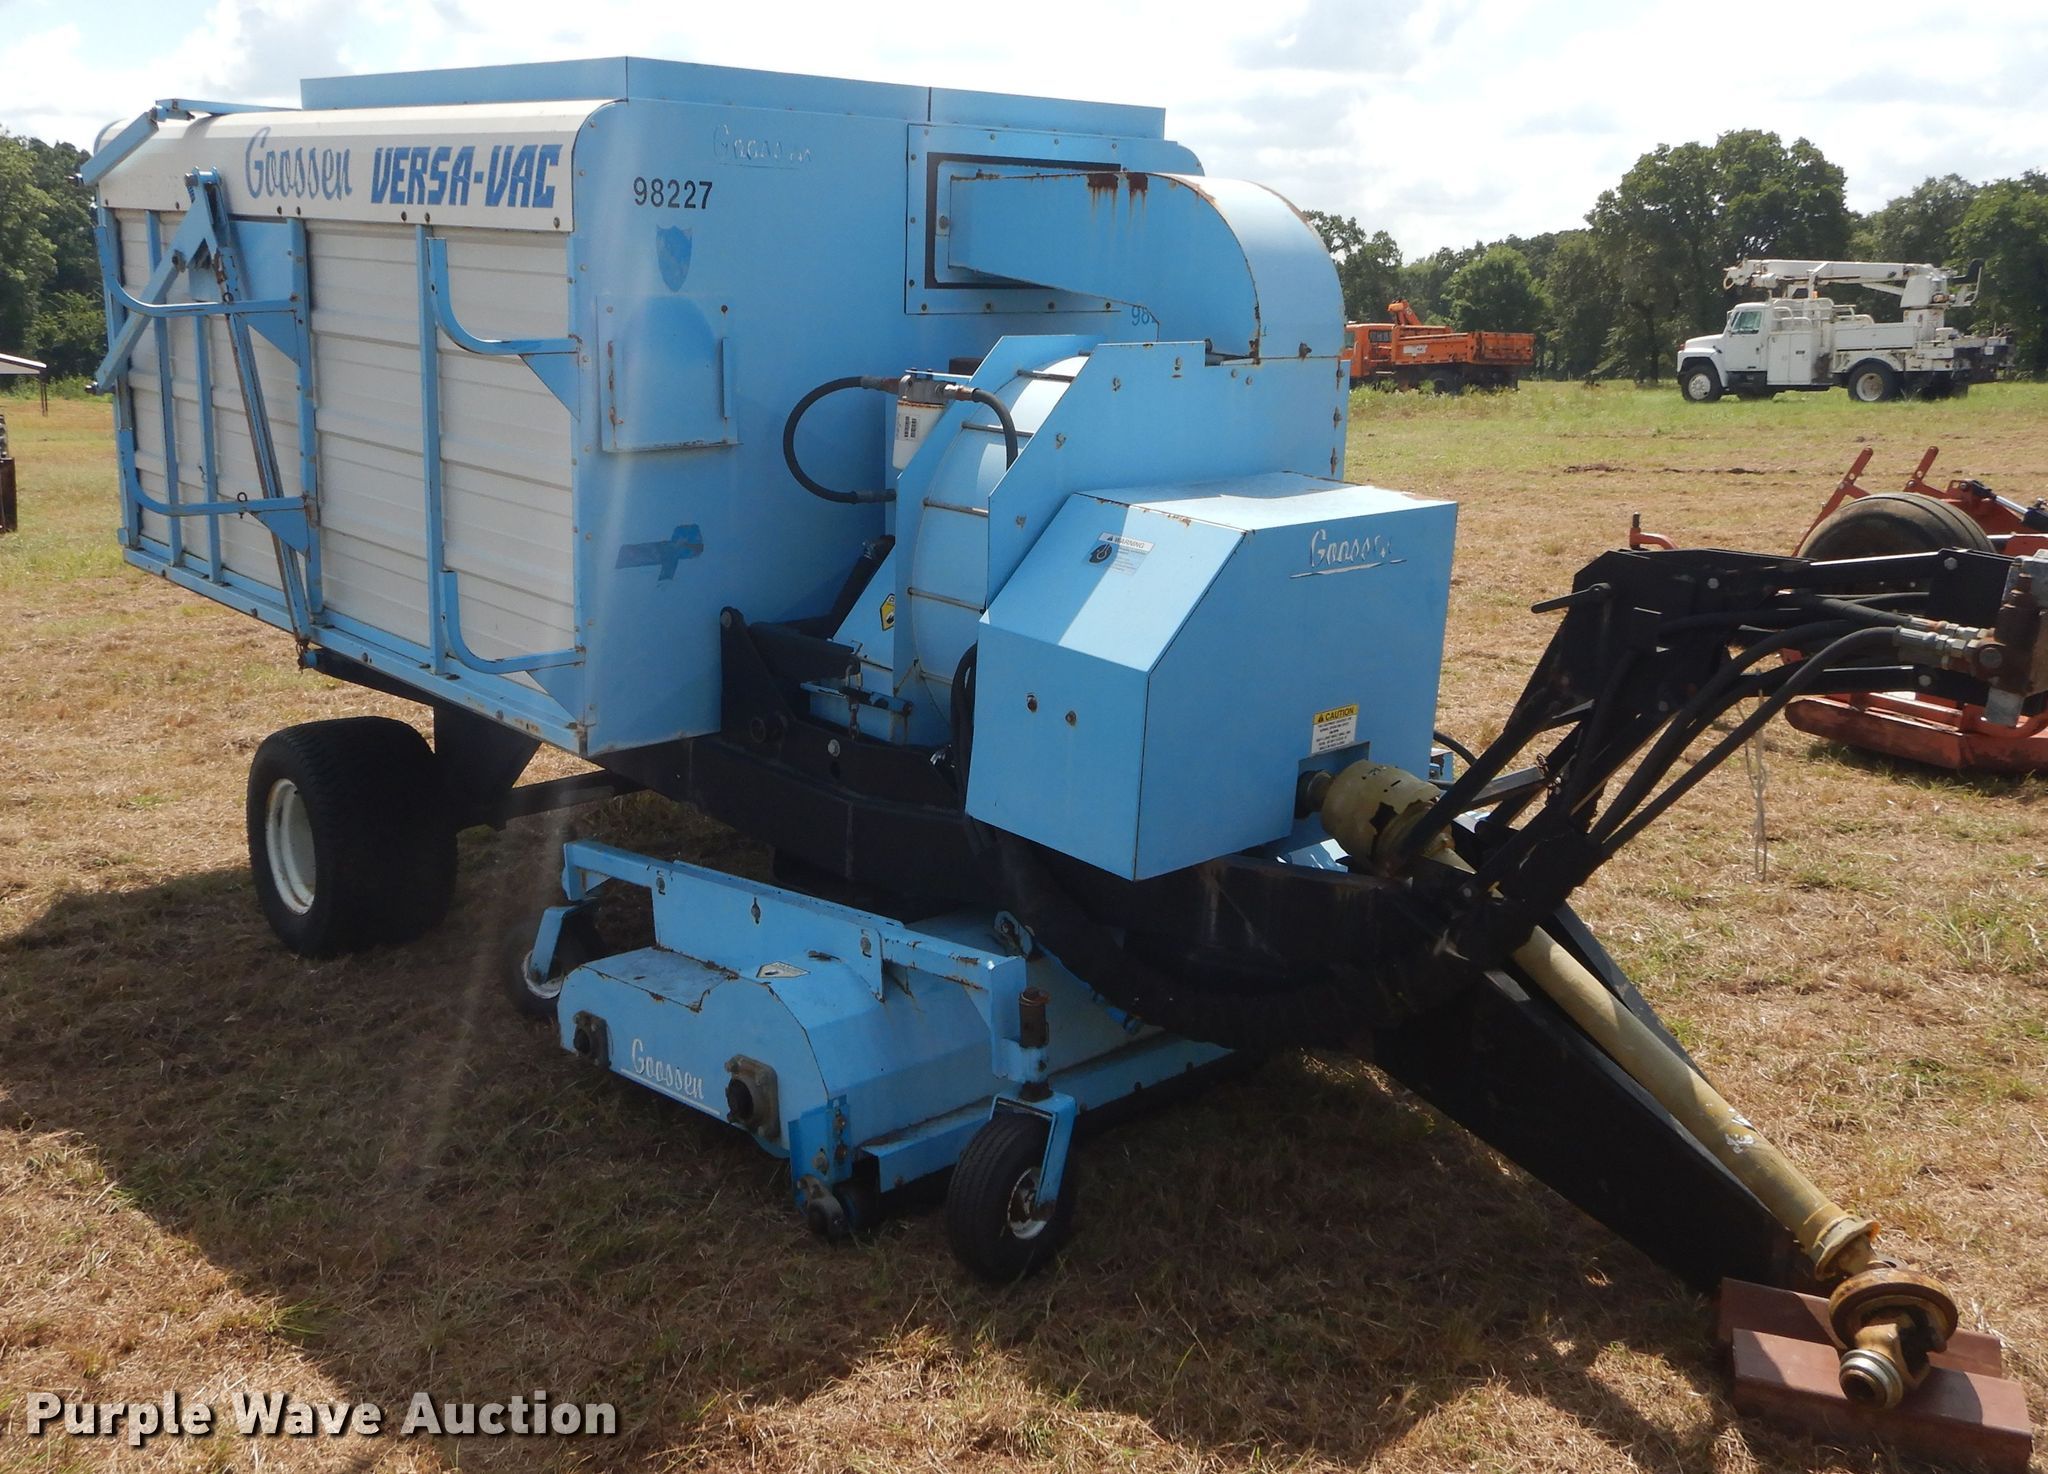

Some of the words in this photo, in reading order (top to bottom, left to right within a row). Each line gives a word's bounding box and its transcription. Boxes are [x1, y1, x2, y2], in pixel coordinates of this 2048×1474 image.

[245, 126, 353, 201] Goossen
[370, 144, 564, 209] VERSA-VAC
[633, 176, 714, 210] 98227
[1131, 305, 1156, 327] 98
[1114, 536, 1145, 549] WARNING
[1325, 706, 1354, 721] CAUTION
[631, 1038, 704, 1100] Goossen
